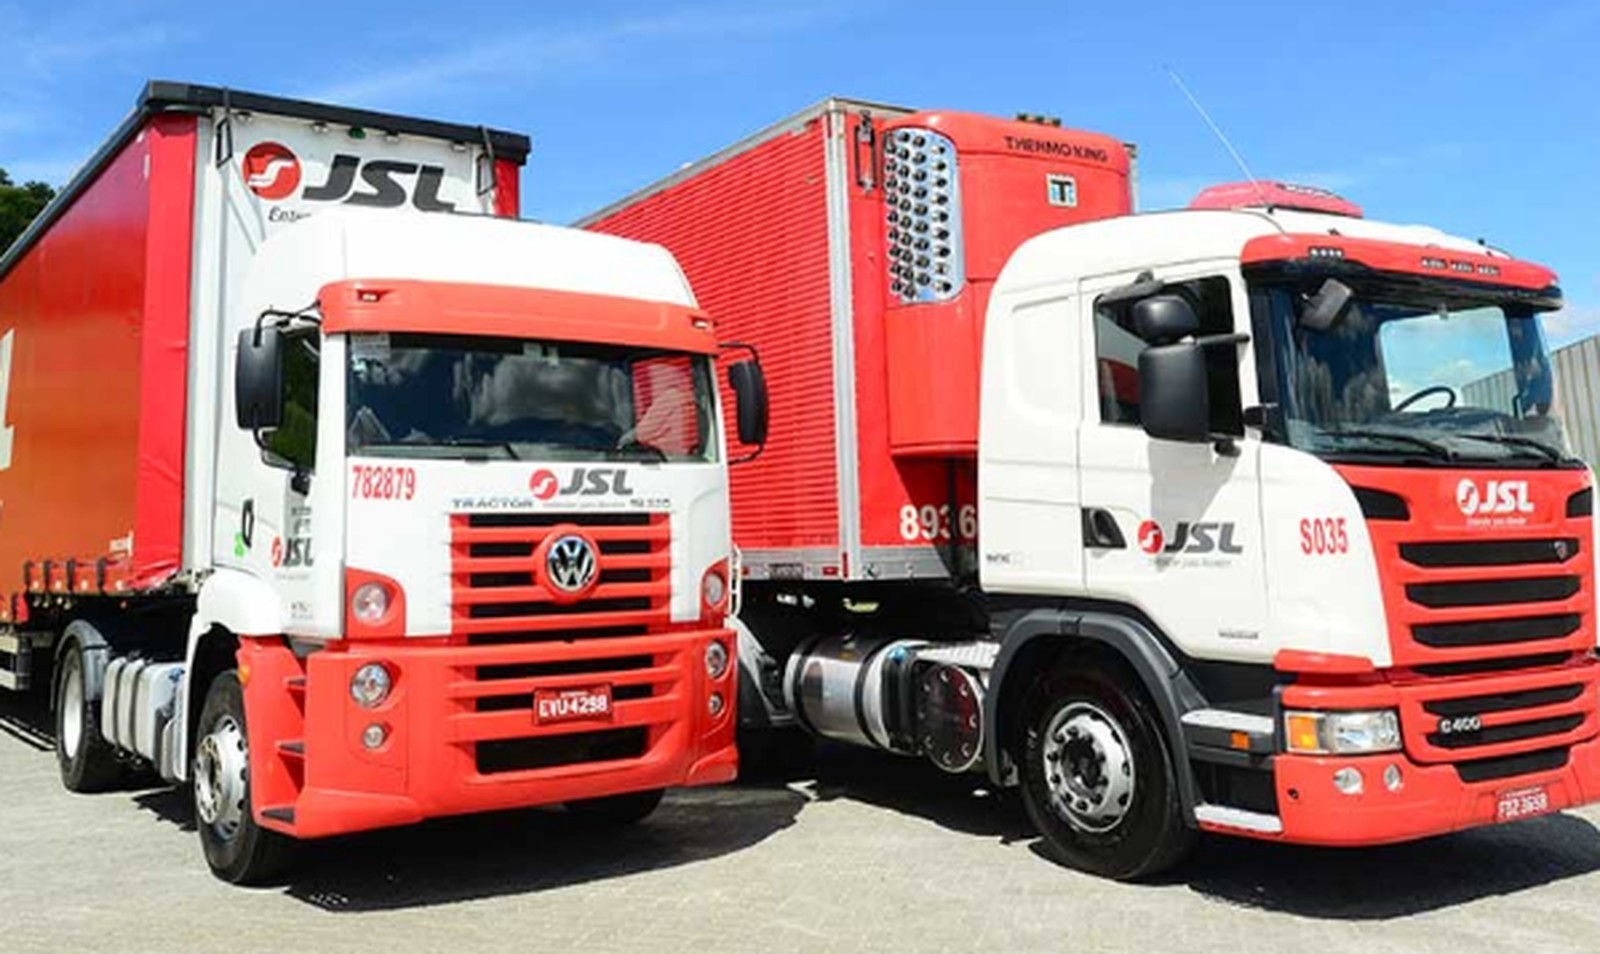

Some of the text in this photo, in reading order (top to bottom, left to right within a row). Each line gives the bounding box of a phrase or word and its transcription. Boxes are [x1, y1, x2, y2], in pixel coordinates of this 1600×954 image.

[1004, 136, 1108, 163] THERMO KING
[302, 154, 455, 212] JSL
[352, 465, 415, 500] 782879
[559, 468, 633, 495] JSL
[1479, 480, 1534, 513] JSL
[283, 537, 314, 567] JSL
[1164, 522, 1243, 554] JSL
[1300, 517, 1348, 555] S035
